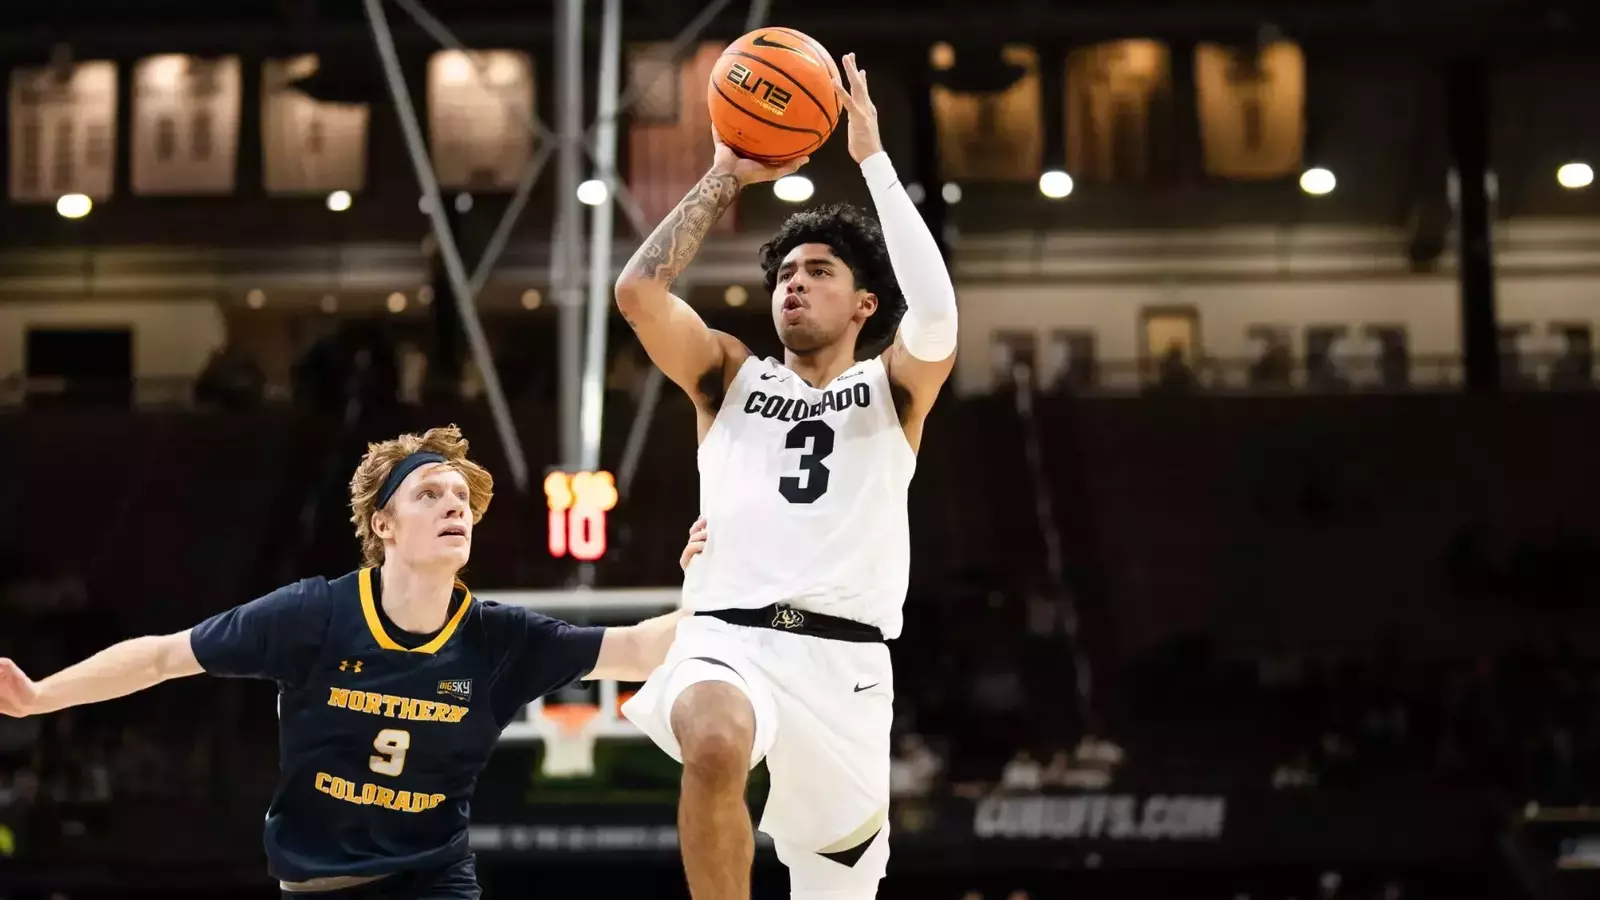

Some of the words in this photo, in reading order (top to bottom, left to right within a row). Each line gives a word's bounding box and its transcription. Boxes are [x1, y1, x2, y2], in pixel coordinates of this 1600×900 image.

[724, 82, 784, 116] CAONSHIP
[726, 63, 792, 112] ELITE
[744, 383, 870, 422] COLORADO
[778, 420, 835, 504] 3
[327, 688, 469, 723] NORTHERN
[369, 728, 411, 777] 9
